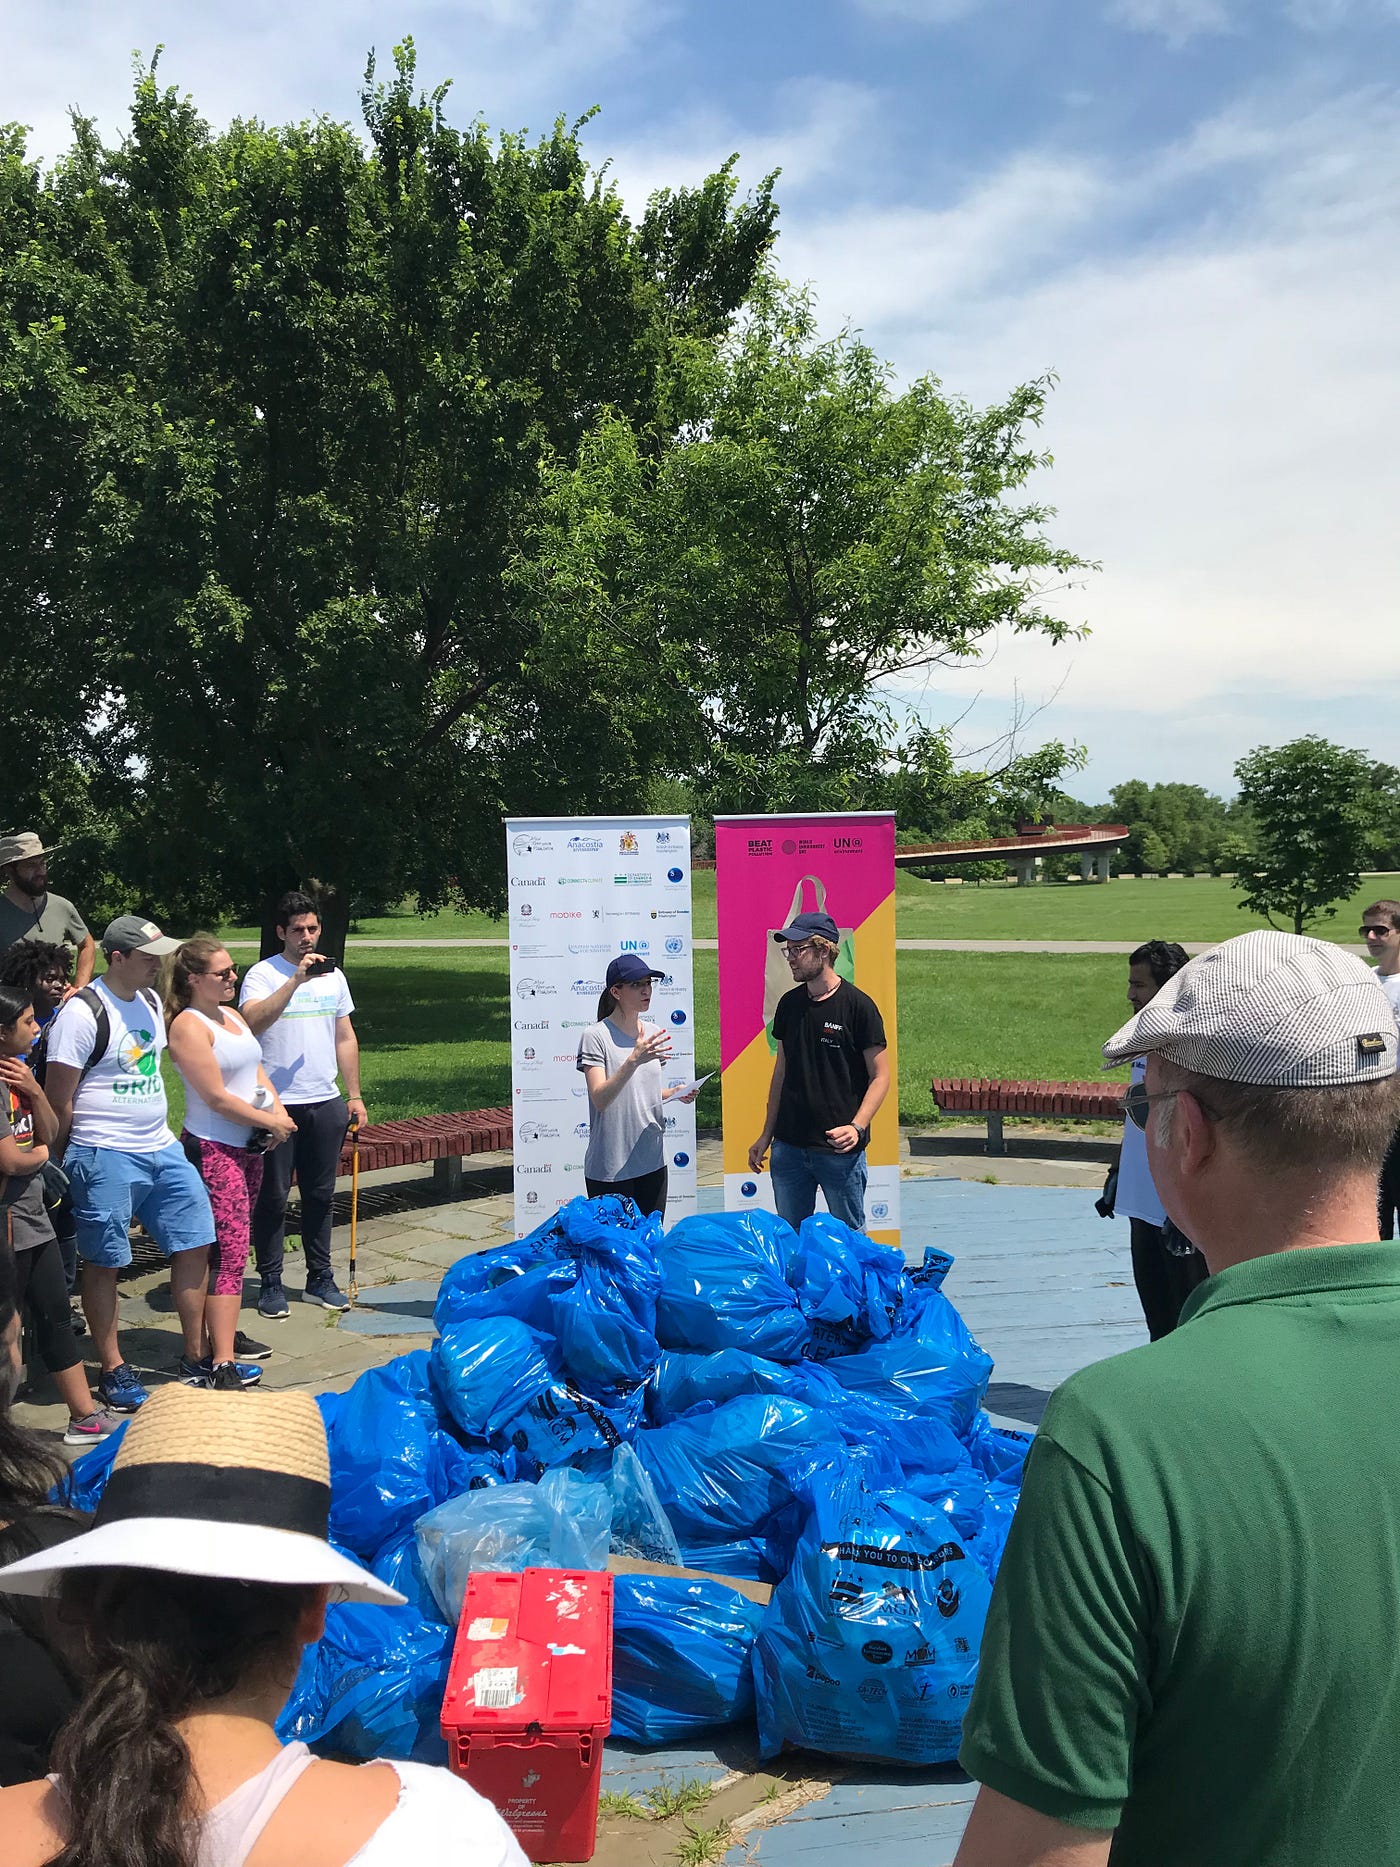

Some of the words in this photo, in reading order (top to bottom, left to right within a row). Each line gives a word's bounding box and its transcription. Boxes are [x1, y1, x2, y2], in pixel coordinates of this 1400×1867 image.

[833, 838, 851, 848] UN
[511, 877, 546, 887] Canada
[550, 911, 582, 919] mobike
[620, 940, 637, 951] UN
[514, 1020, 549, 1031] Canada
[112, 1075, 161, 1096] GRID
[516, 1163, 552, 1175] Canada
[864, 1550, 883, 1561] YOU
[886, 1554, 898, 1564] TO
